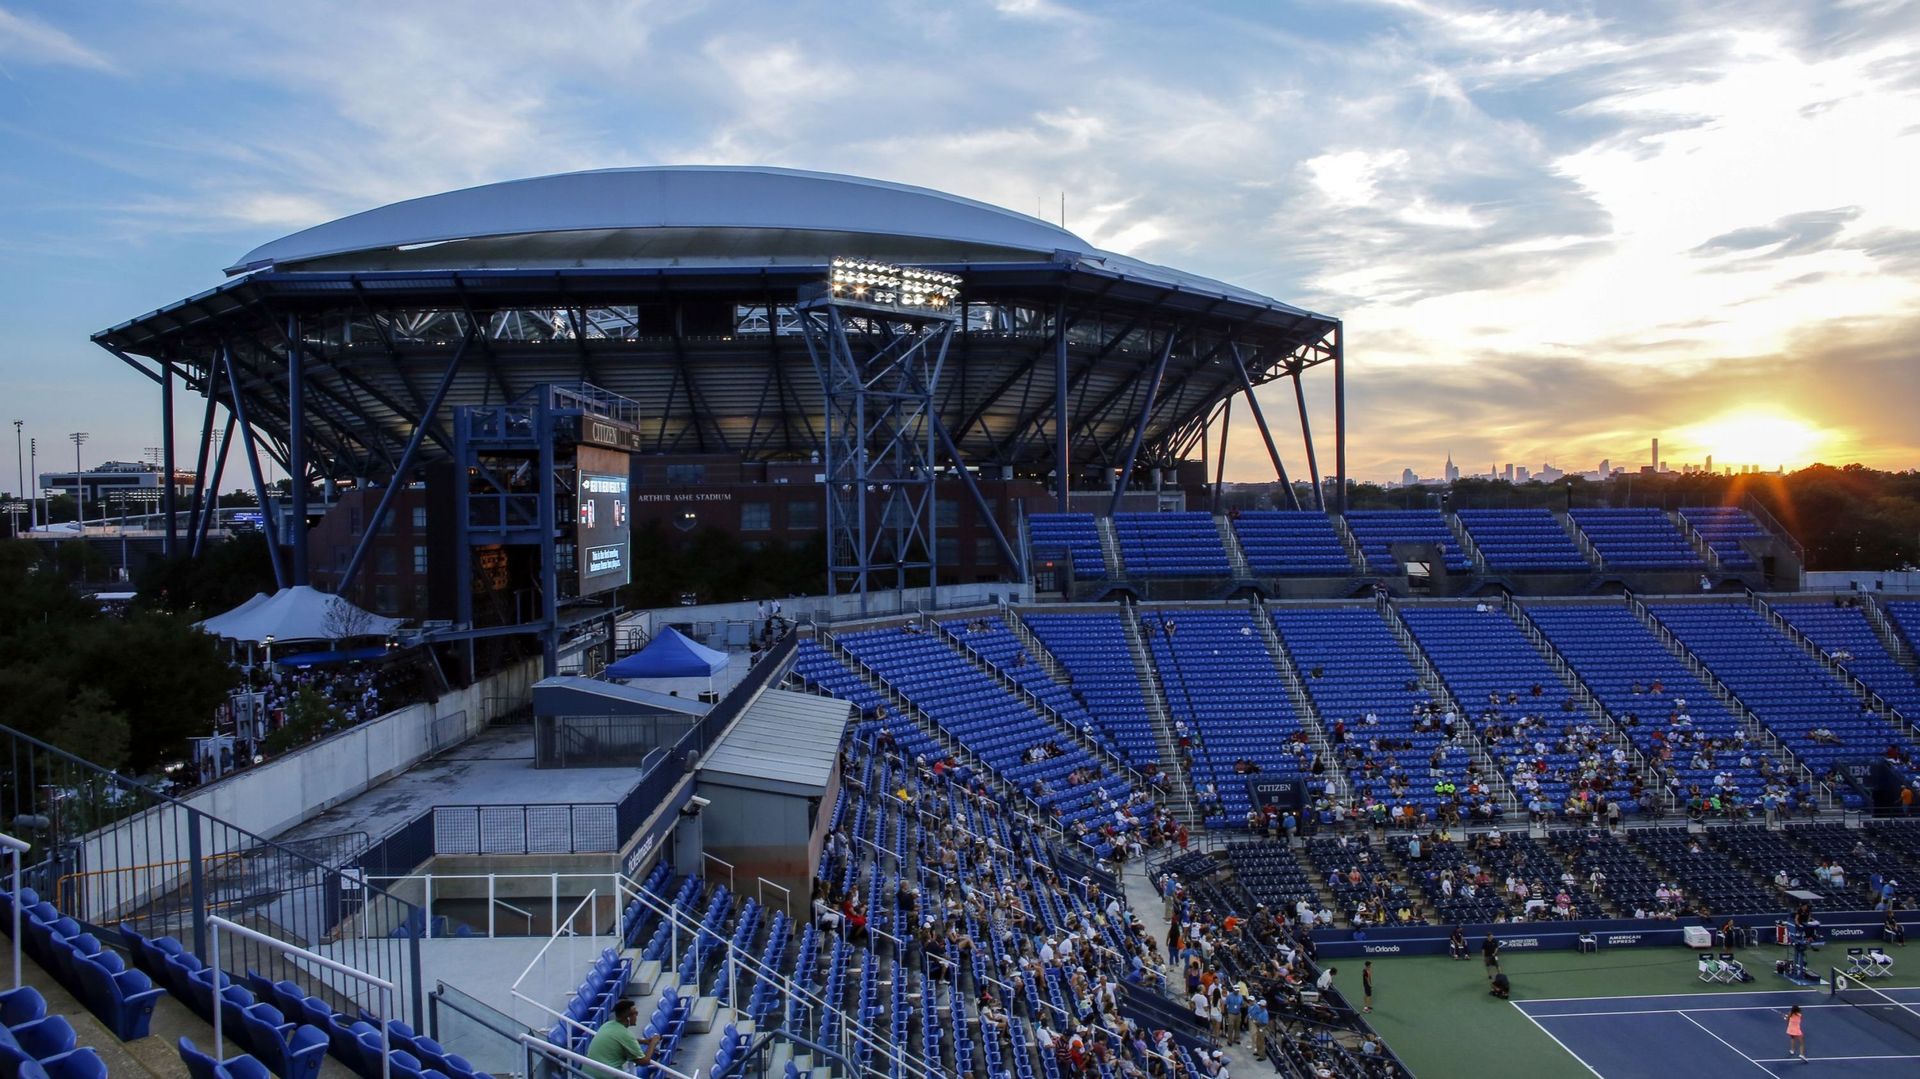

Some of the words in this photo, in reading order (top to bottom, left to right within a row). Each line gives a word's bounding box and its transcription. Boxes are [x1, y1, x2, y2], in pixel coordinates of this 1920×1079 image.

[593, 422, 617, 445] CITIZEN
[638, 494, 671, 502] ARTHUR
[673, 493, 695, 501] ASHE
[695, 493, 731, 501] STADIUM
[1849, 765, 1871, 776] IBM
[1257, 783, 1291, 792] CITIZEN
[628, 832, 655, 875] ticketmaster
[1374, 944, 1400, 953] Orlando
